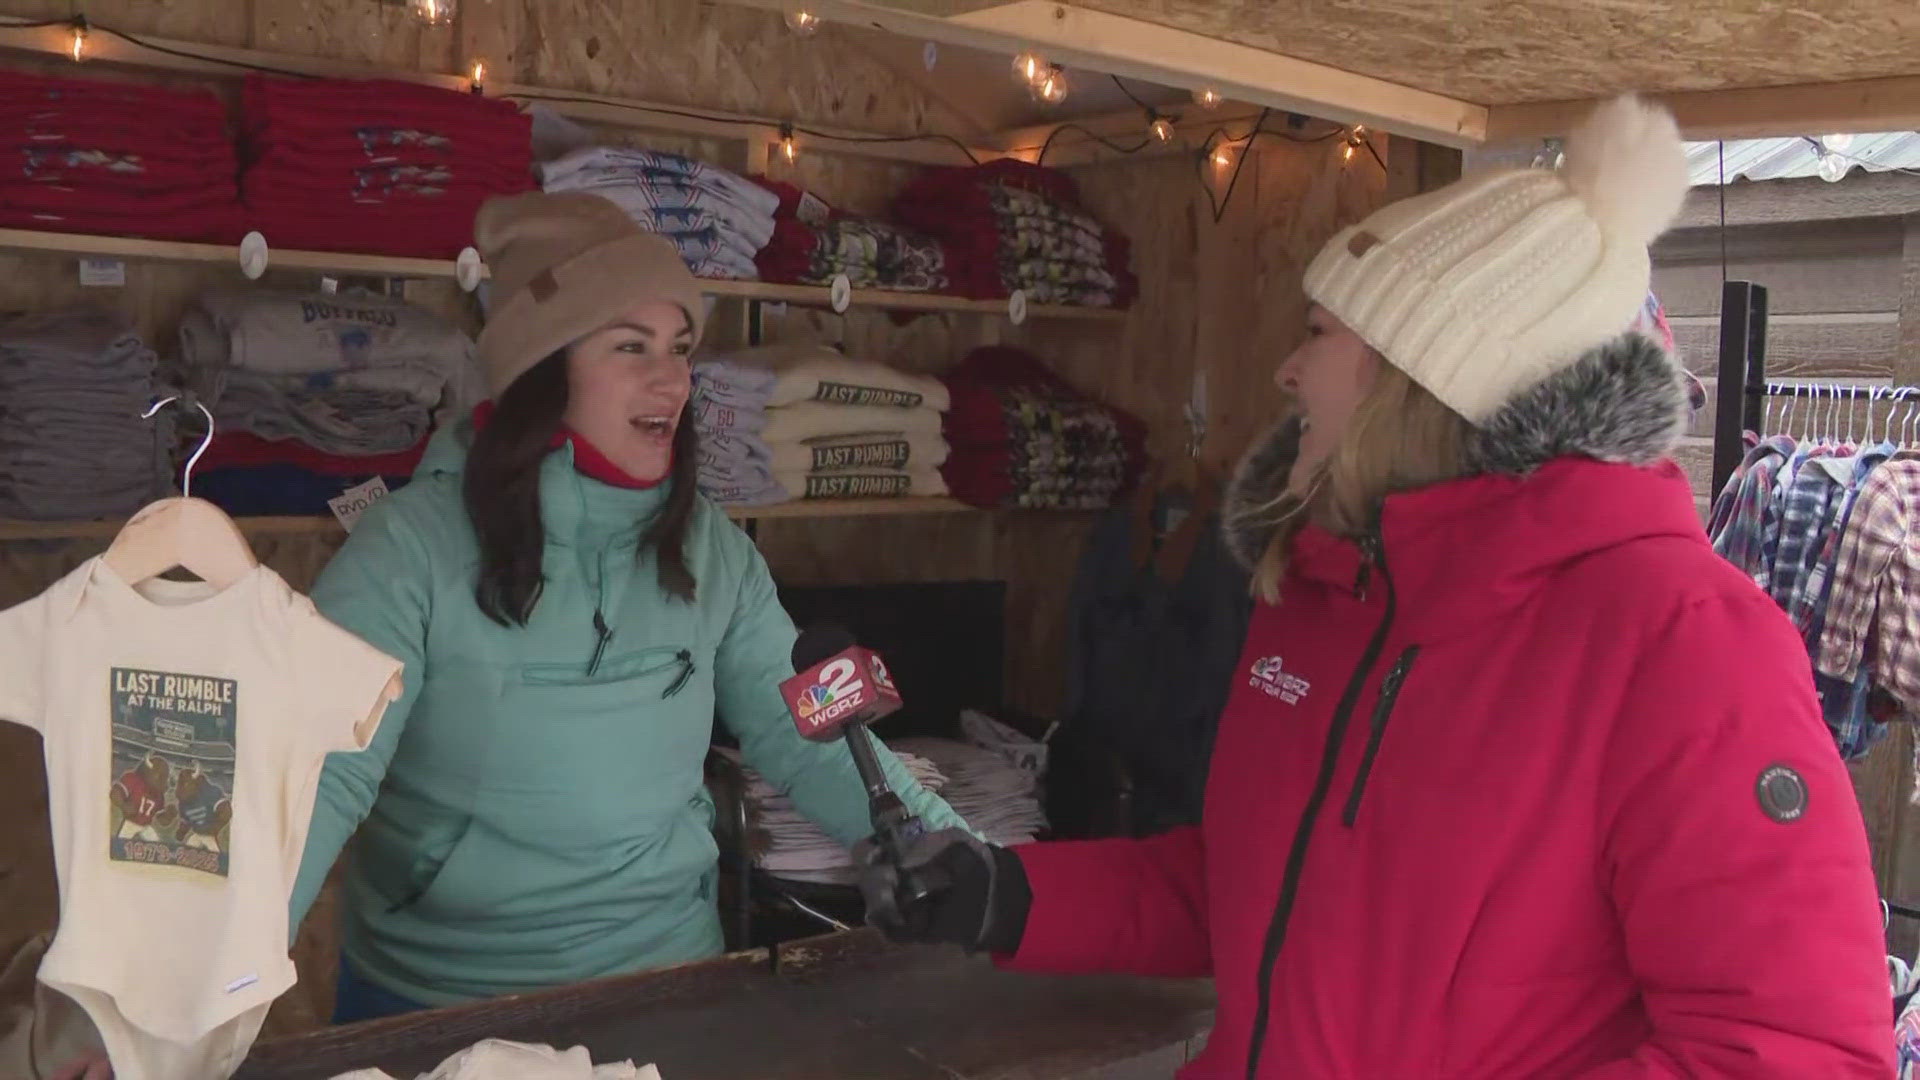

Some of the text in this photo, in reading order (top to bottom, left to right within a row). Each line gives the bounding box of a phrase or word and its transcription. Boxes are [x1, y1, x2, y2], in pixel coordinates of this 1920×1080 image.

[816, 442, 906, 468] LAST RUMBLE
[810, 477, 908, 497] LAST RUMBLE
[116, 671, 232, 703] LAST RUMBLE
[819, 658, 864, 701] 2
[127, 693, 221, 716] AT THE RALPH
[808, 690, 864, 727] WGRZ
[139, 796, 155, 816] 17
